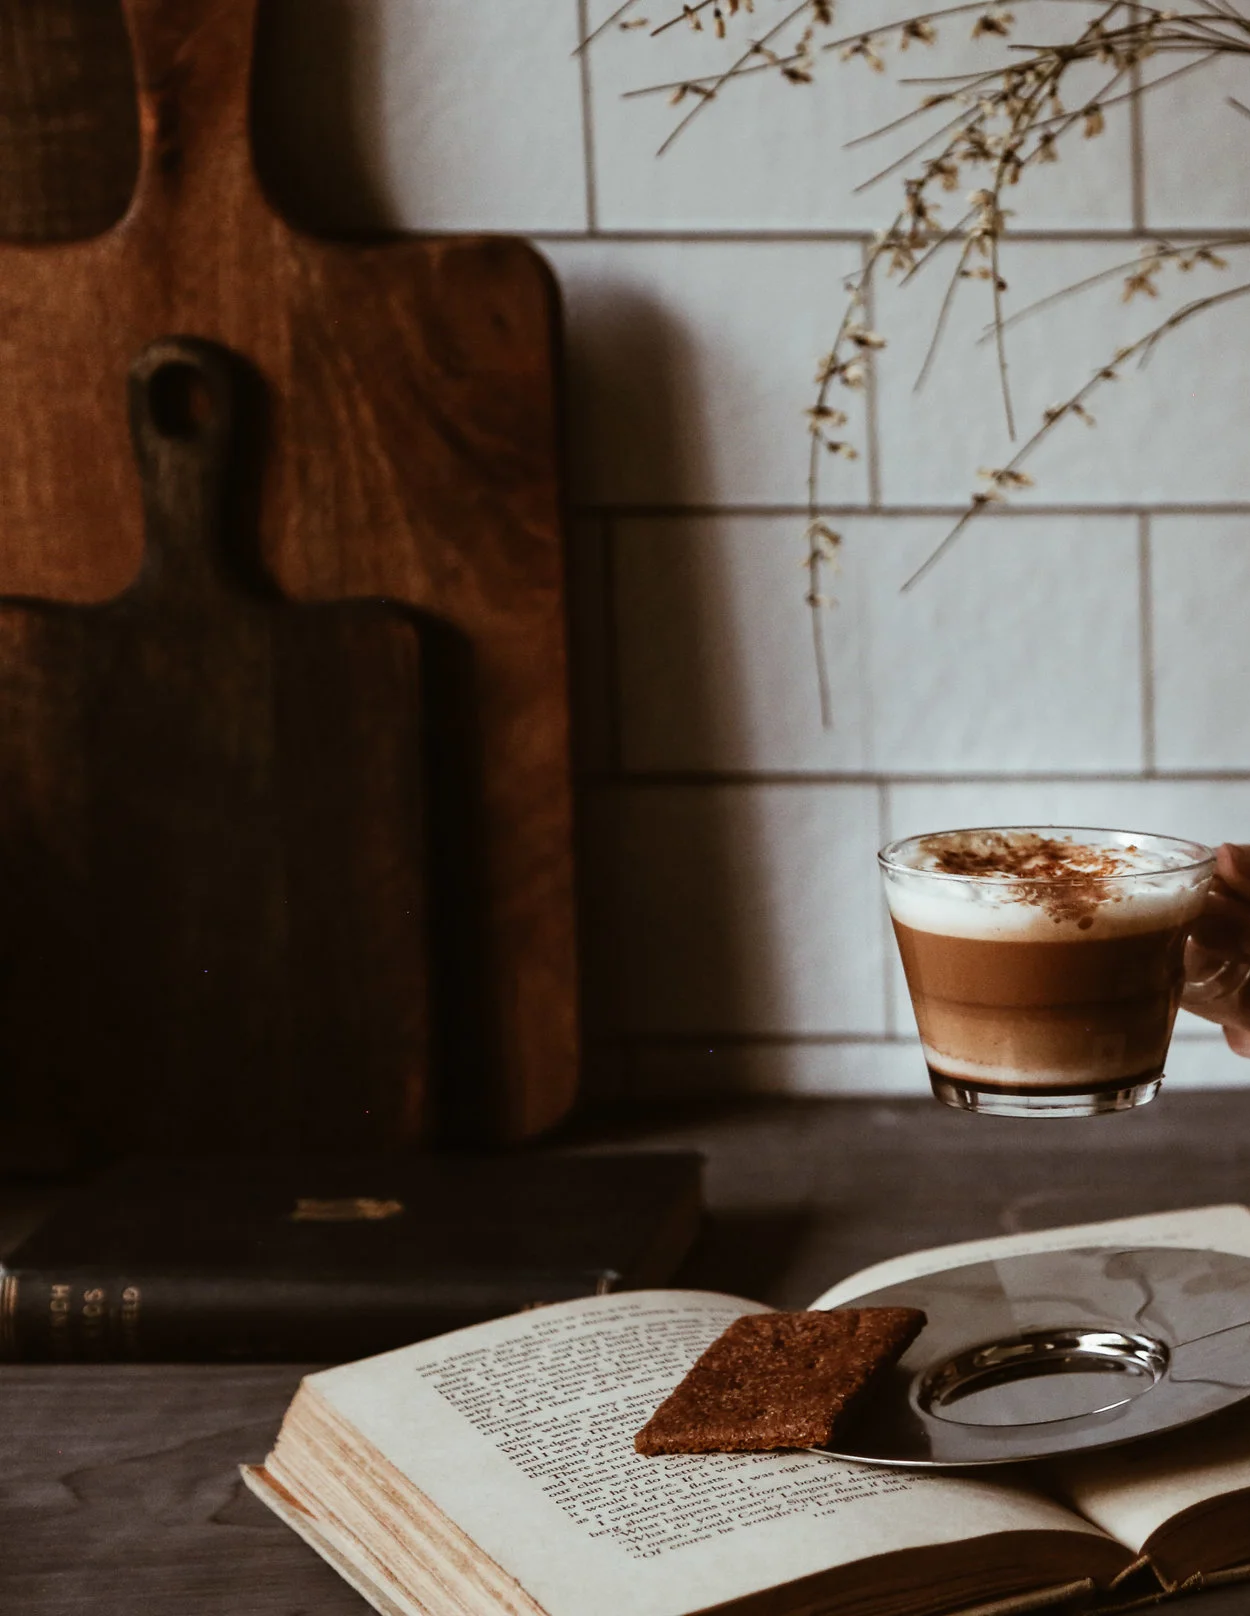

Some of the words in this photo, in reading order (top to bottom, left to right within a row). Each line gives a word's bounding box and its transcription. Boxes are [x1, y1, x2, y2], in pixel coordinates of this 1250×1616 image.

[495, 1433, 532, 1447] under
[541, 1419, 581, 1433] which
[588, 1406, 619, 1418] we'd
[501, 1438, 543, 1452] White
[550, 1427, 583, 1438] were
[588, 1409, 646, 1426] dragging
[508, 1449, 532, 1460] and
[585, 1425, 614, 1434] The
[619, 1416, 647, 1426] rope
[514, 1417, 559, 1433] looked
[563, 1407, 591, 1418] over
[597, 1401, 617, 1409] my
[515, 1455, 540, 1466] and
[552, 1444, 577, 1454] was
[580, 1434, 608, 1447] glad
[522, 1449, 589, 1472] apparently
[595, 1440, 620, 1449] was
[528, 1459, 585, 1478] thoughts
[591, 1451, 604, 1459] of
[548, 1465, 590, 1479] There
[594, 1455, 626, 1466] were
[542, 1480, 566, 1491] and
[582, 1469, 608, 1478] was
[610, 1457, 641, 1470] hard
[548, 1488, 571, 1497] our
[577, 1474, 618, 1489] cheese
[664, 1453, 684, 1462] we
[555, 1487, 603, 1504] captain
[610, 1469, 658, 1486] wanted
[664, 1450, 717, 1470] Cooky's
[585, 1495, 627, 1511] would
[715, 1462, 747, 1472] were
[609, 1483, 639, 1495] he'd
[664, 1465, 703, 1478] better
[727, 1450, 755, 1461] leav
[588, 1525, 621, 1537] berg
[625, 1511, 666, 1526] shows
[671, 1498, 710, 1512] above
[608, 1502, 638, 1514] cake
[644, 1494, 658, 1502] of
[662, 1488, 684, 1497] ice
[610, 1498, 675, 1521] wondered
[679, 1482, 733, 1500] whether
[749, 1472, 774, 1480] was
[663, 1505, 718, 1523] happens
[749, 1484, 791, 1497] frozen
[673, 1519, 690, 1530] do
[696, 1512, 722, 1524] you
[780, 1481, 843, 1498] Langman
[691, 1516, 734, 1533] would
[737, 1504, 782, 1518] Cooky
[786, 1492, 829, 1505] Sipper
[834, 1485, 864, 1494] float
[669, 1534, 712, 1549] course
[813, 1491, 878, 1506] Langman
